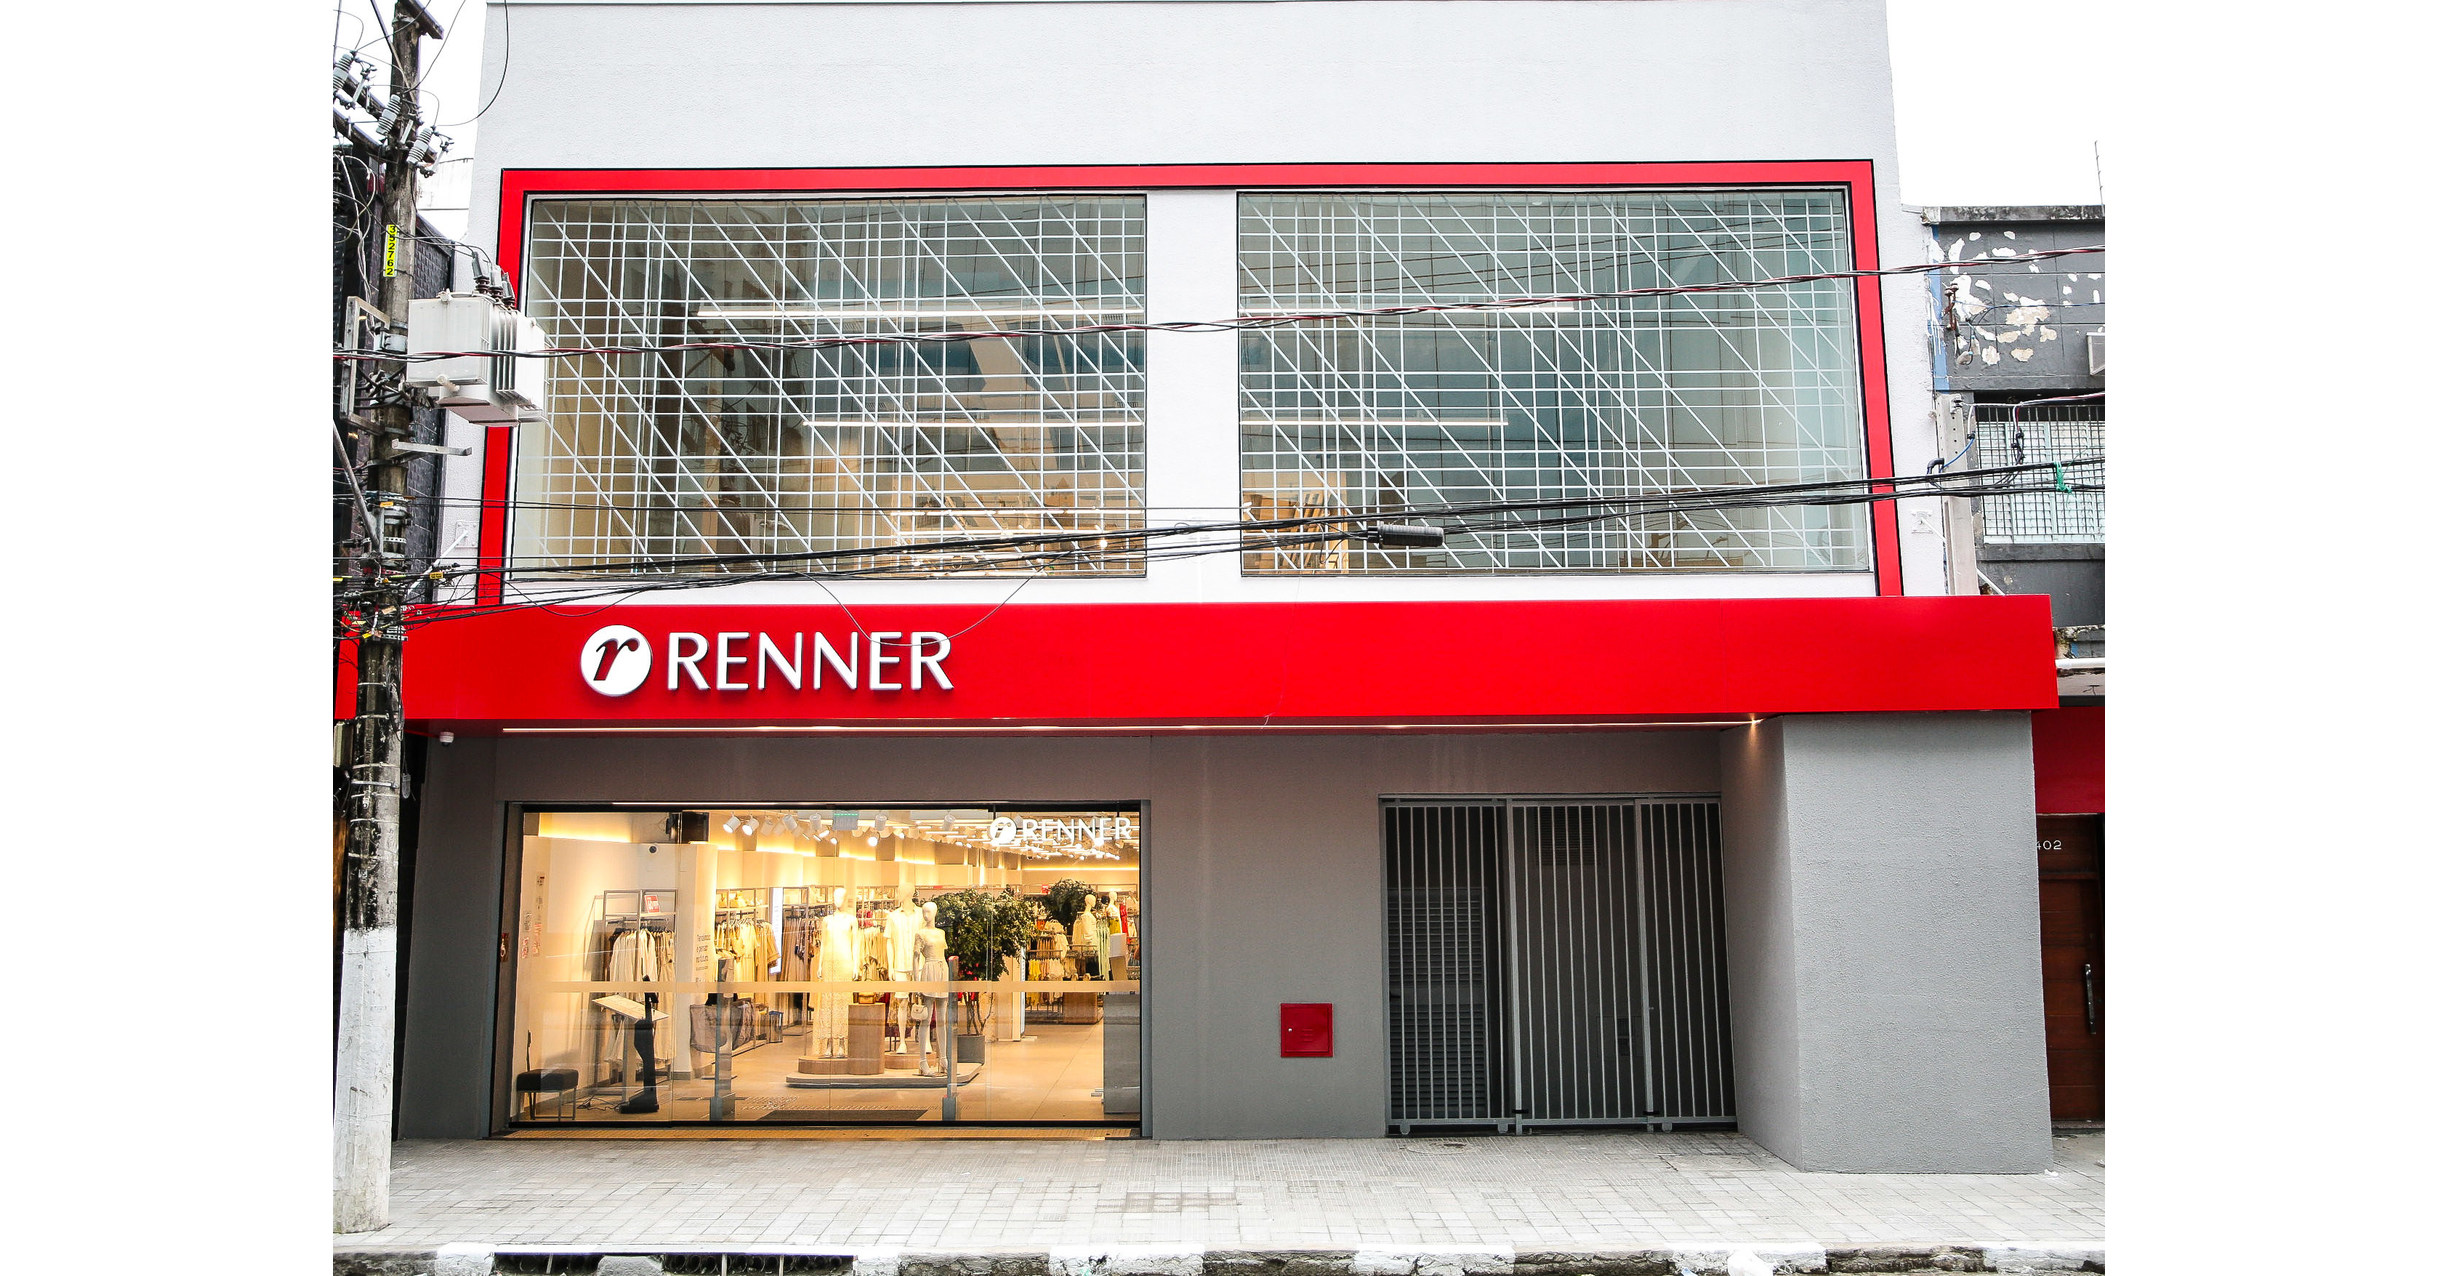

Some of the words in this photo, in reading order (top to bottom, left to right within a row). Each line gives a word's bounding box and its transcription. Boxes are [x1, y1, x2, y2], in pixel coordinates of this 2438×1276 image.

[387, 225, 396, 276] 352762
[667, 632, 954, 691] RENNER
[1022, 817, 1133, 842] RENNER
